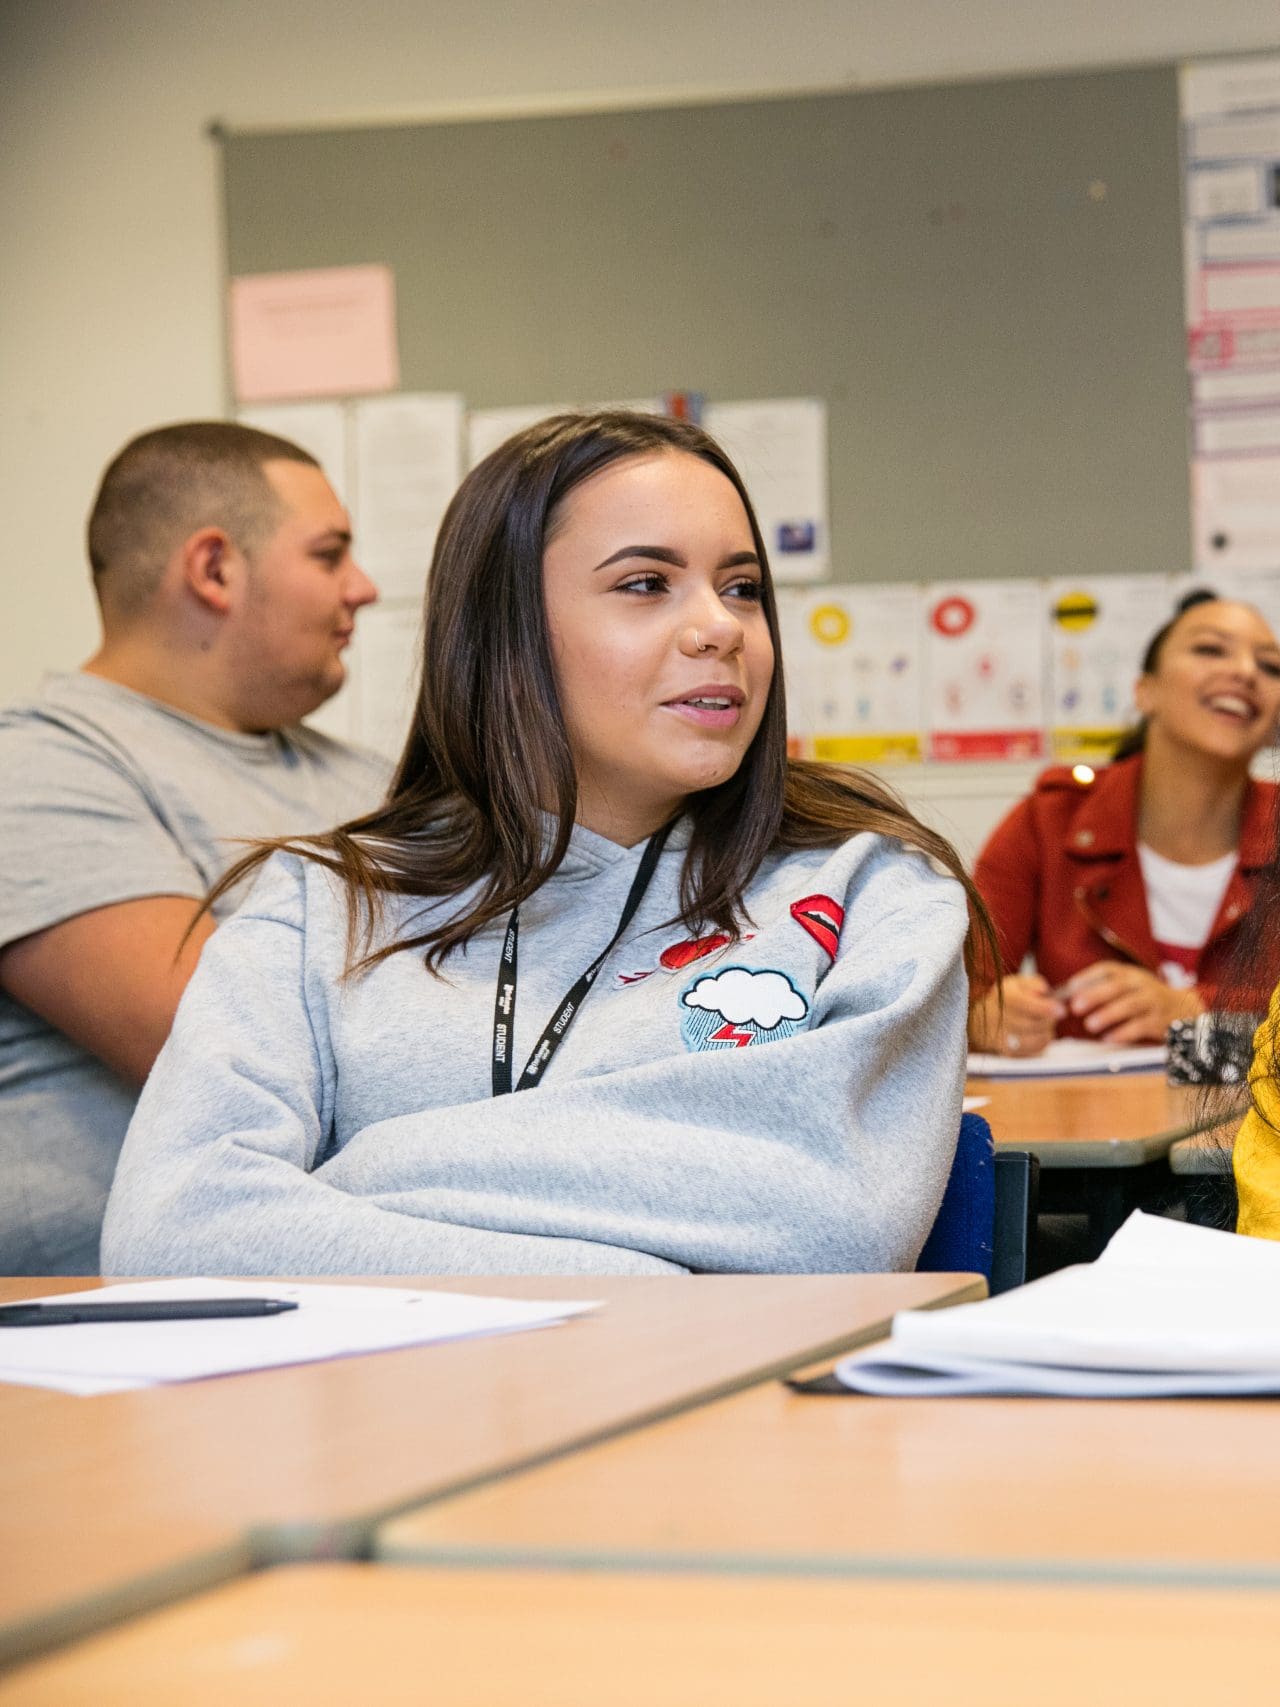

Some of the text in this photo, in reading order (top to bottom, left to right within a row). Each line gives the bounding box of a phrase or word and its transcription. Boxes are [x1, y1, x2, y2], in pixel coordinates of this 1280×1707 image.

[504, 927, 515, 964] STUDENT
[553, 1001, 575, 1034] STUDENT
[495, 1023, 507, 1063] STUDENT
